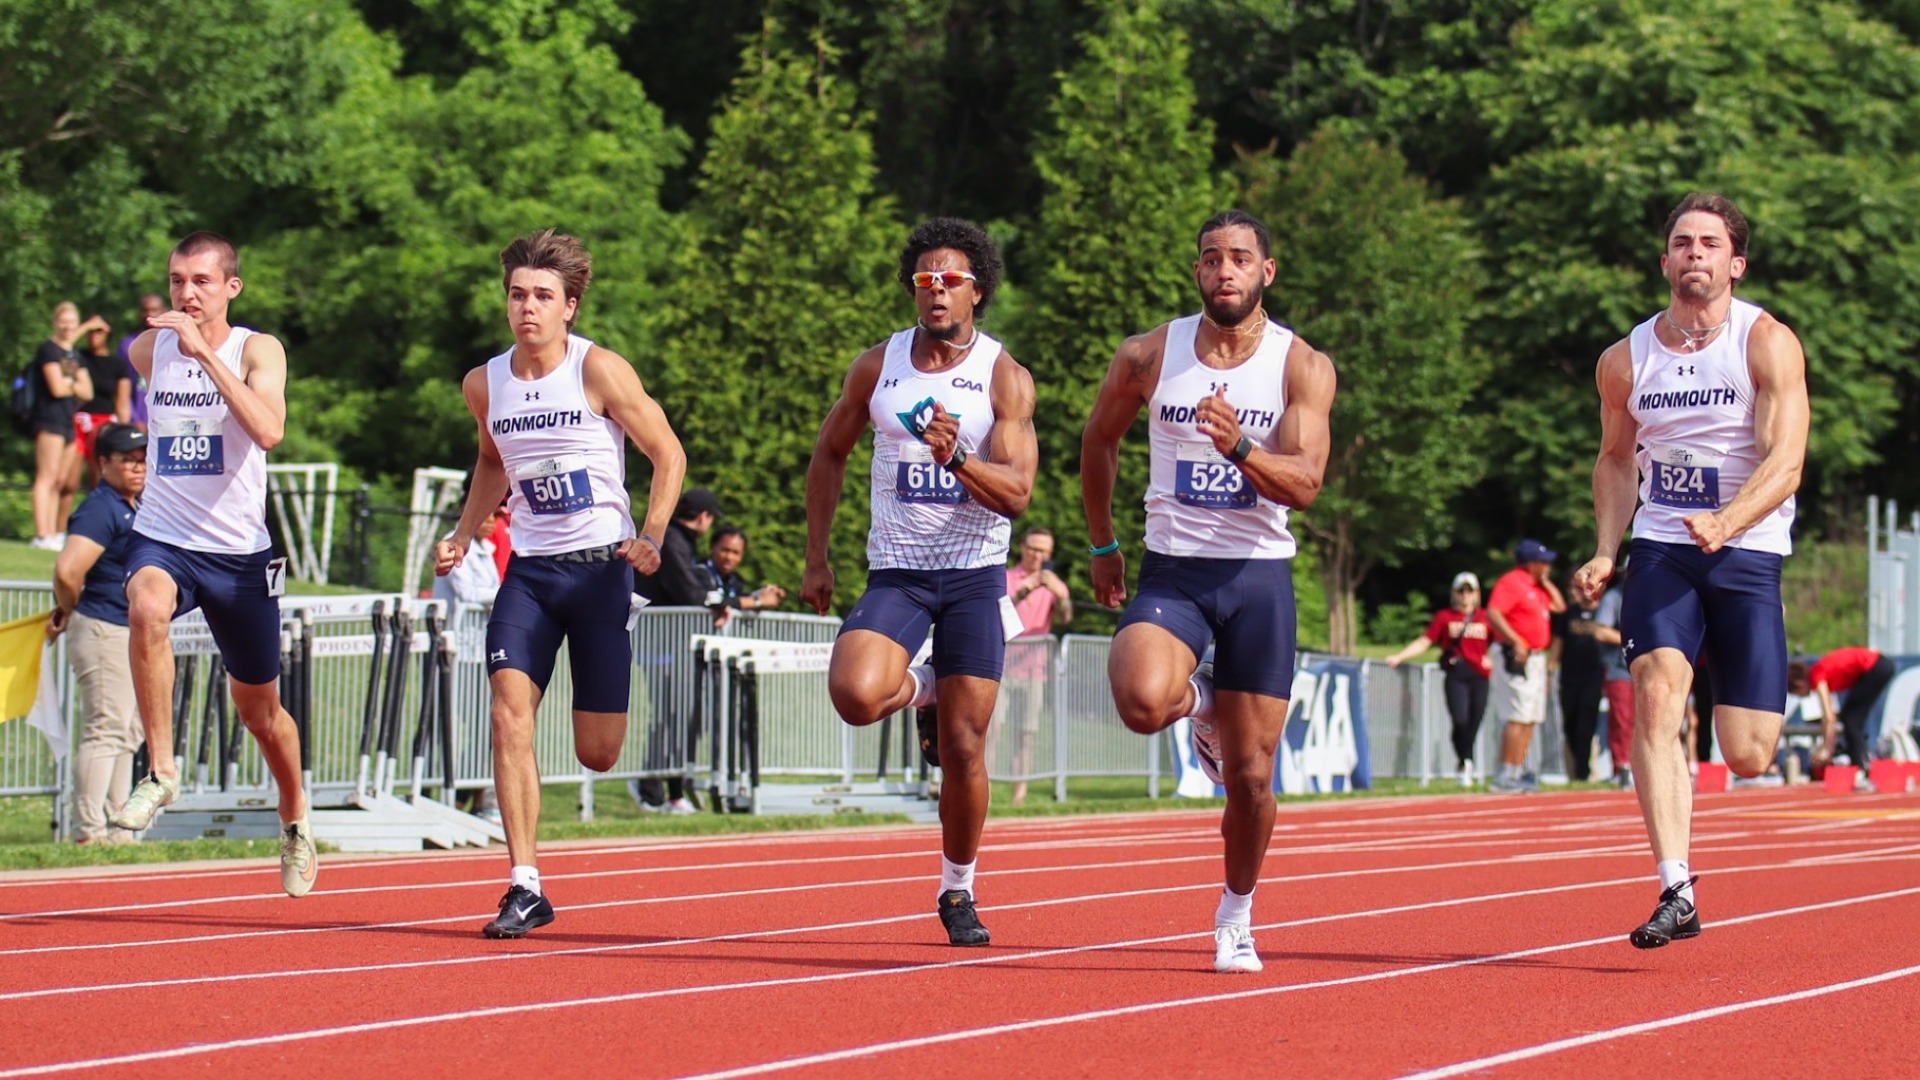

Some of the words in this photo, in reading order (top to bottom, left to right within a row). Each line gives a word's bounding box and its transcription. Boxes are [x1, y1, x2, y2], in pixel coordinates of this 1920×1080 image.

[951, 377, 983, 393] CAA
[153, 391, 227, 407] MONMOUT
[1638, 388, 1735, 411] MONMOUTH
[492, 410, 582, 436] MONMOUTH
[1160, 404, 1275, 428] MONUTH
[168, 437, 211, 461] 499
[531, 472, 575, 503] 501
[907, 463, 956, 489] 616
[1190, 463, 1243, 493] 523
[1660, 465, 1705, 493] 524
[267, 562, 283, 590] 7
